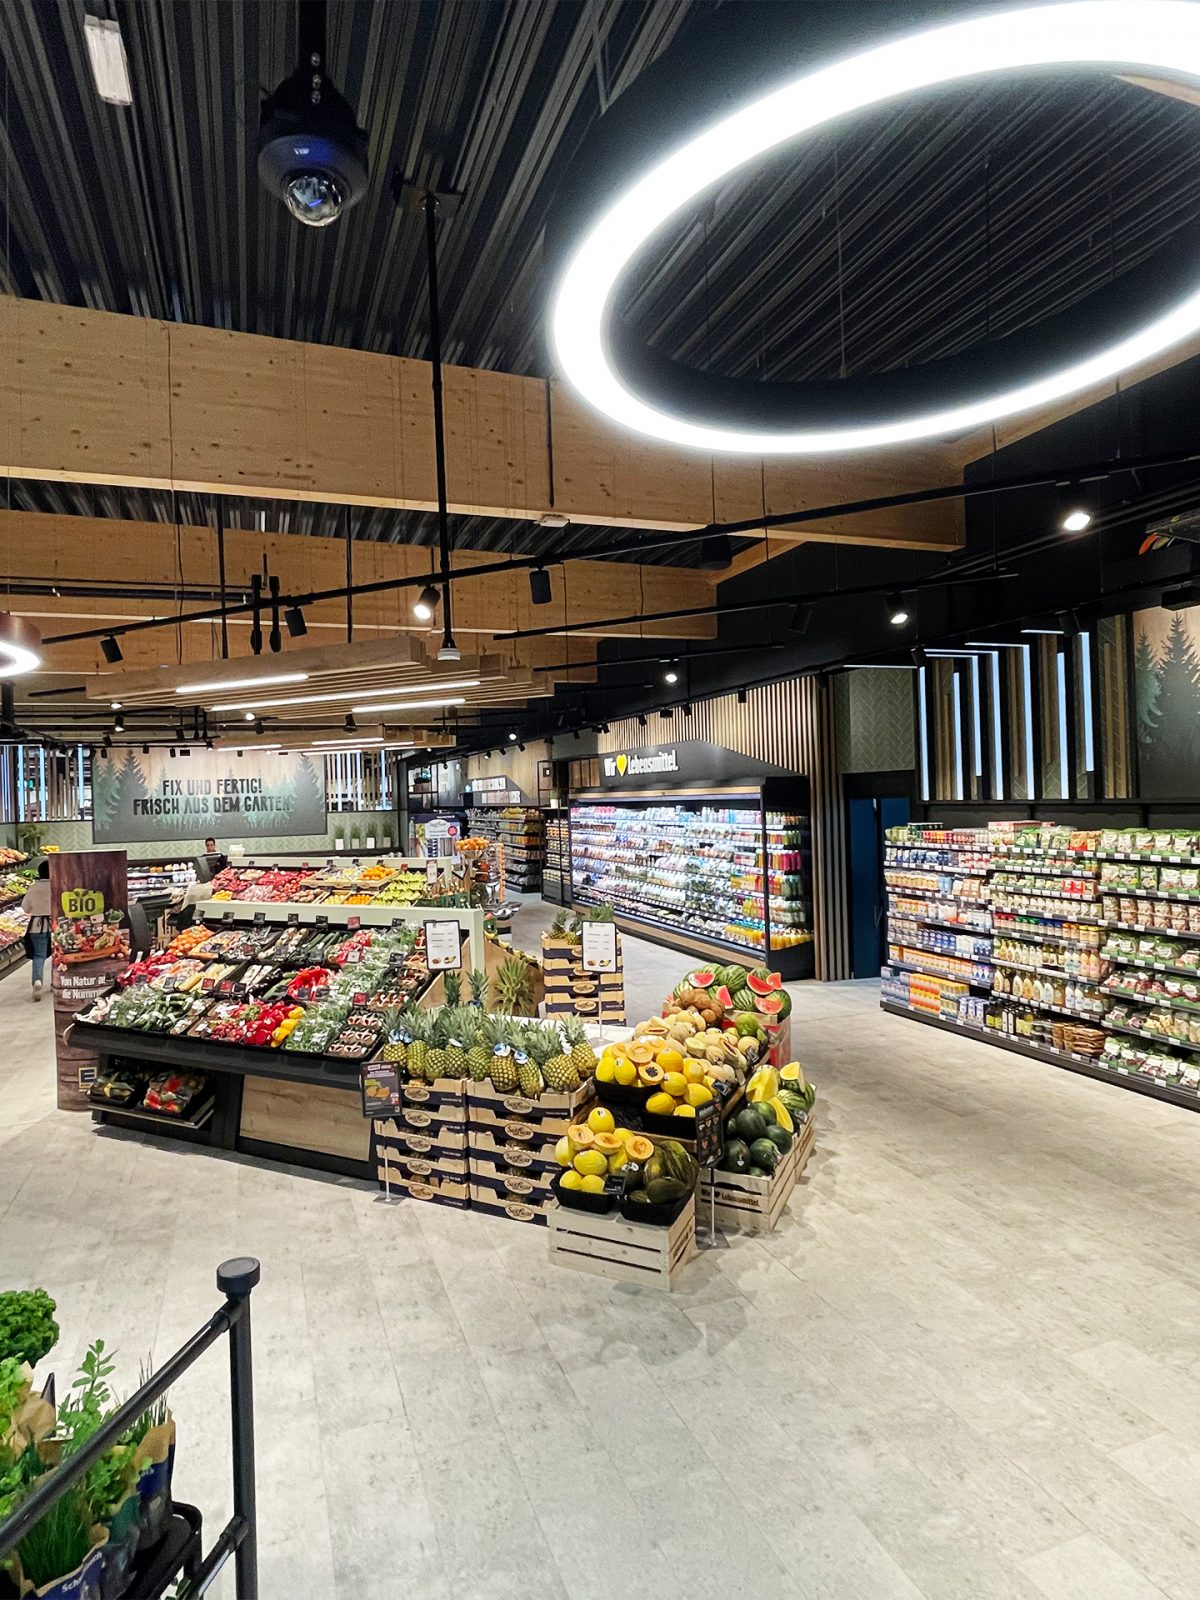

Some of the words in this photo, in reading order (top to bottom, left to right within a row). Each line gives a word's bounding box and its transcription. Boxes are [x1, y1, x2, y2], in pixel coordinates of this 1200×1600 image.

[163, 779, 183, 796] FIX
[187, 779, 211, 795] UND
[217, 778, 263, 795] FERTIG!
[133, 797, 179, 816] FRISCH
[184, 797, 209, 815] AUS
[213, 796, 240, 813] DEM
[244, 795, 291, 812] GARTEN
[68, 897, 96, 913] BIO
[60, 975, 72, 987] Von
[73, 975, 97, 987] Natur
